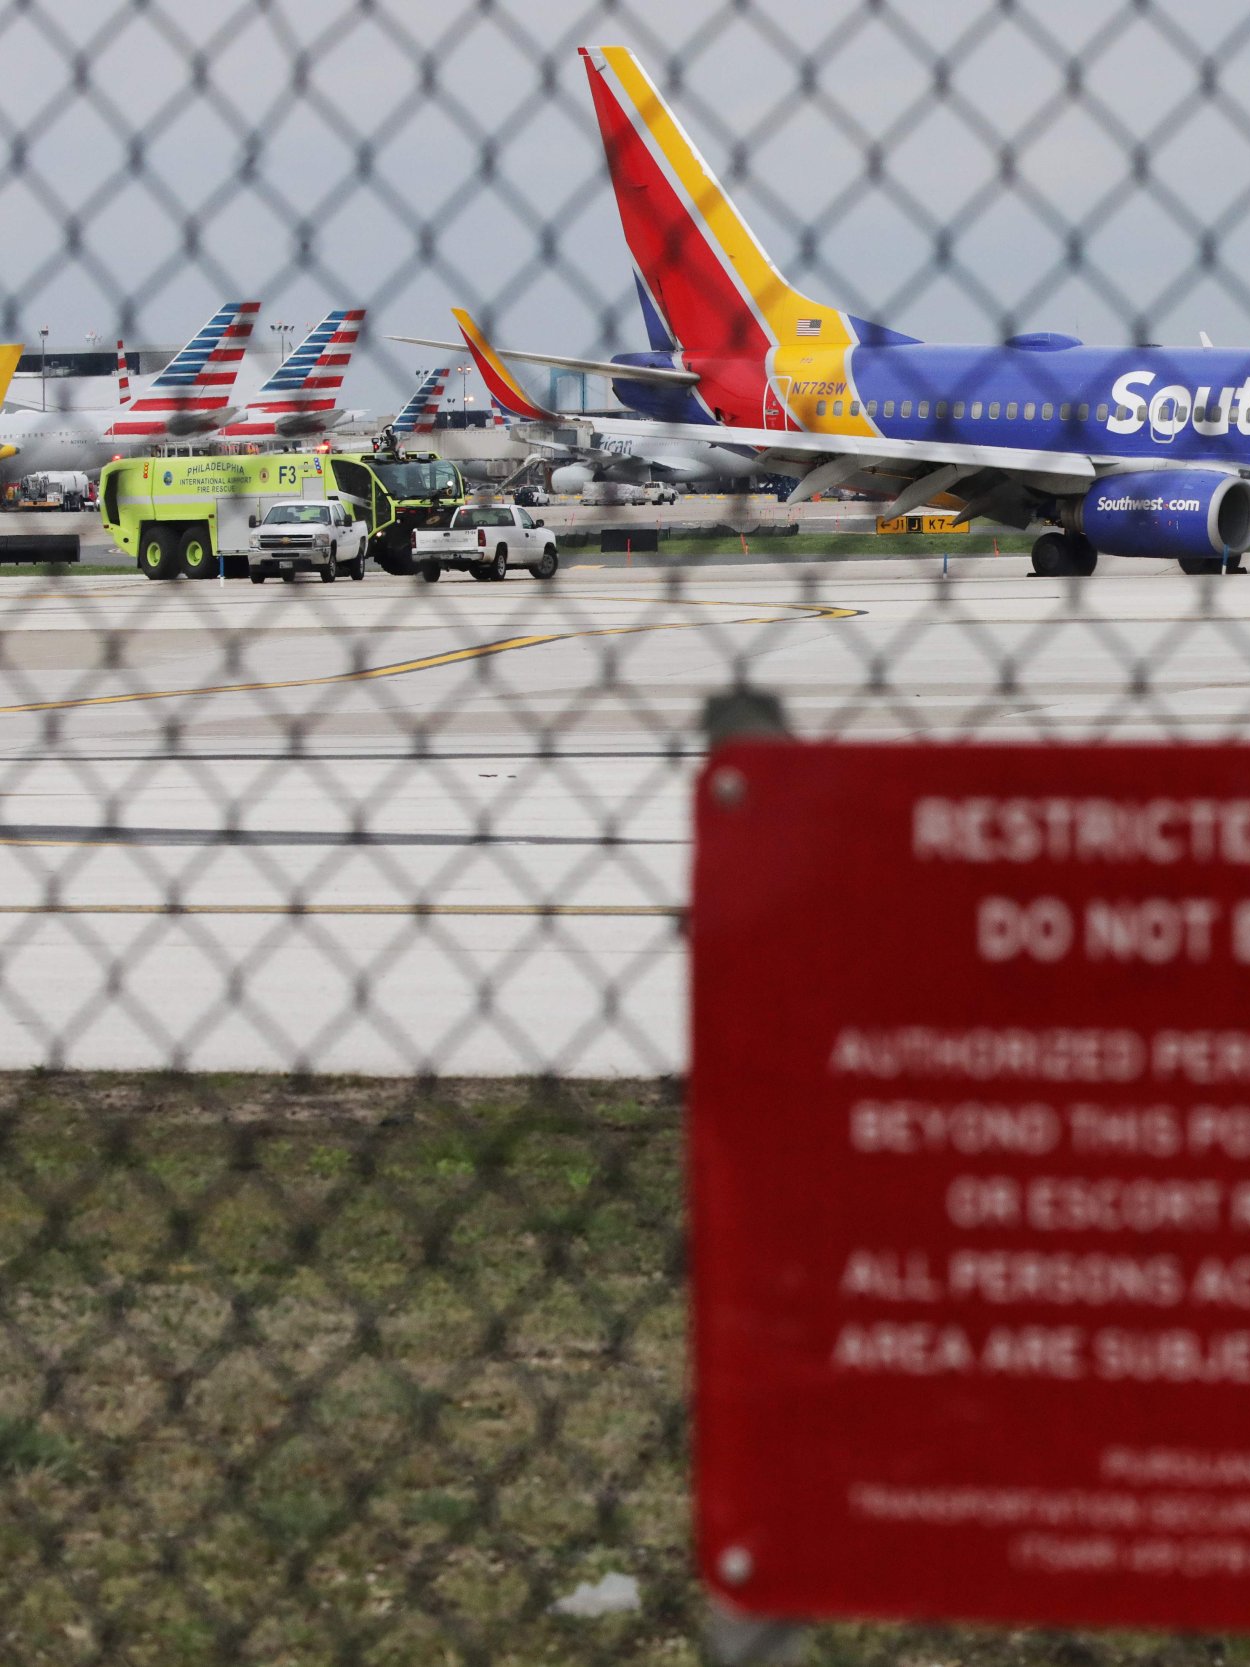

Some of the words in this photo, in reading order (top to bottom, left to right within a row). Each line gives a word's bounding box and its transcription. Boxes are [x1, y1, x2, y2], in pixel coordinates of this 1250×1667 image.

[792, 381, 848, 396] N772SW
[179, 477, 226, 486] INTERNATIONAL
[227, 476, 252, 485] AIRPORT
[187, 461, 245, 477] PHILADELPHIA
[278, 465, 297, 485] F3
[197, 485, 210, 493] FIRE
[211, 485, 235, 493] RESCUE
[893, 519, 904, 530] J1
[977, 895, 1073, 963] DO
[1085, 897, 1218, 964] NOT
[830, 1026, 1146, 1083] AUTHORIZED
[850, 1099, 1060, 1155] BEYOND
[1069, 1102, 1183, 1157] THIS
[947, 1175, 1021, 1229] OR
[1026, 1177, 1223, 1232] ESCORT
[841, 1249, 940, 1303] ALL
[949, 1250, 1184, 1306] PERSONS
[833, 1321, 975, 1375] AREA
[982, 1325, 1083, 1379] ARE
